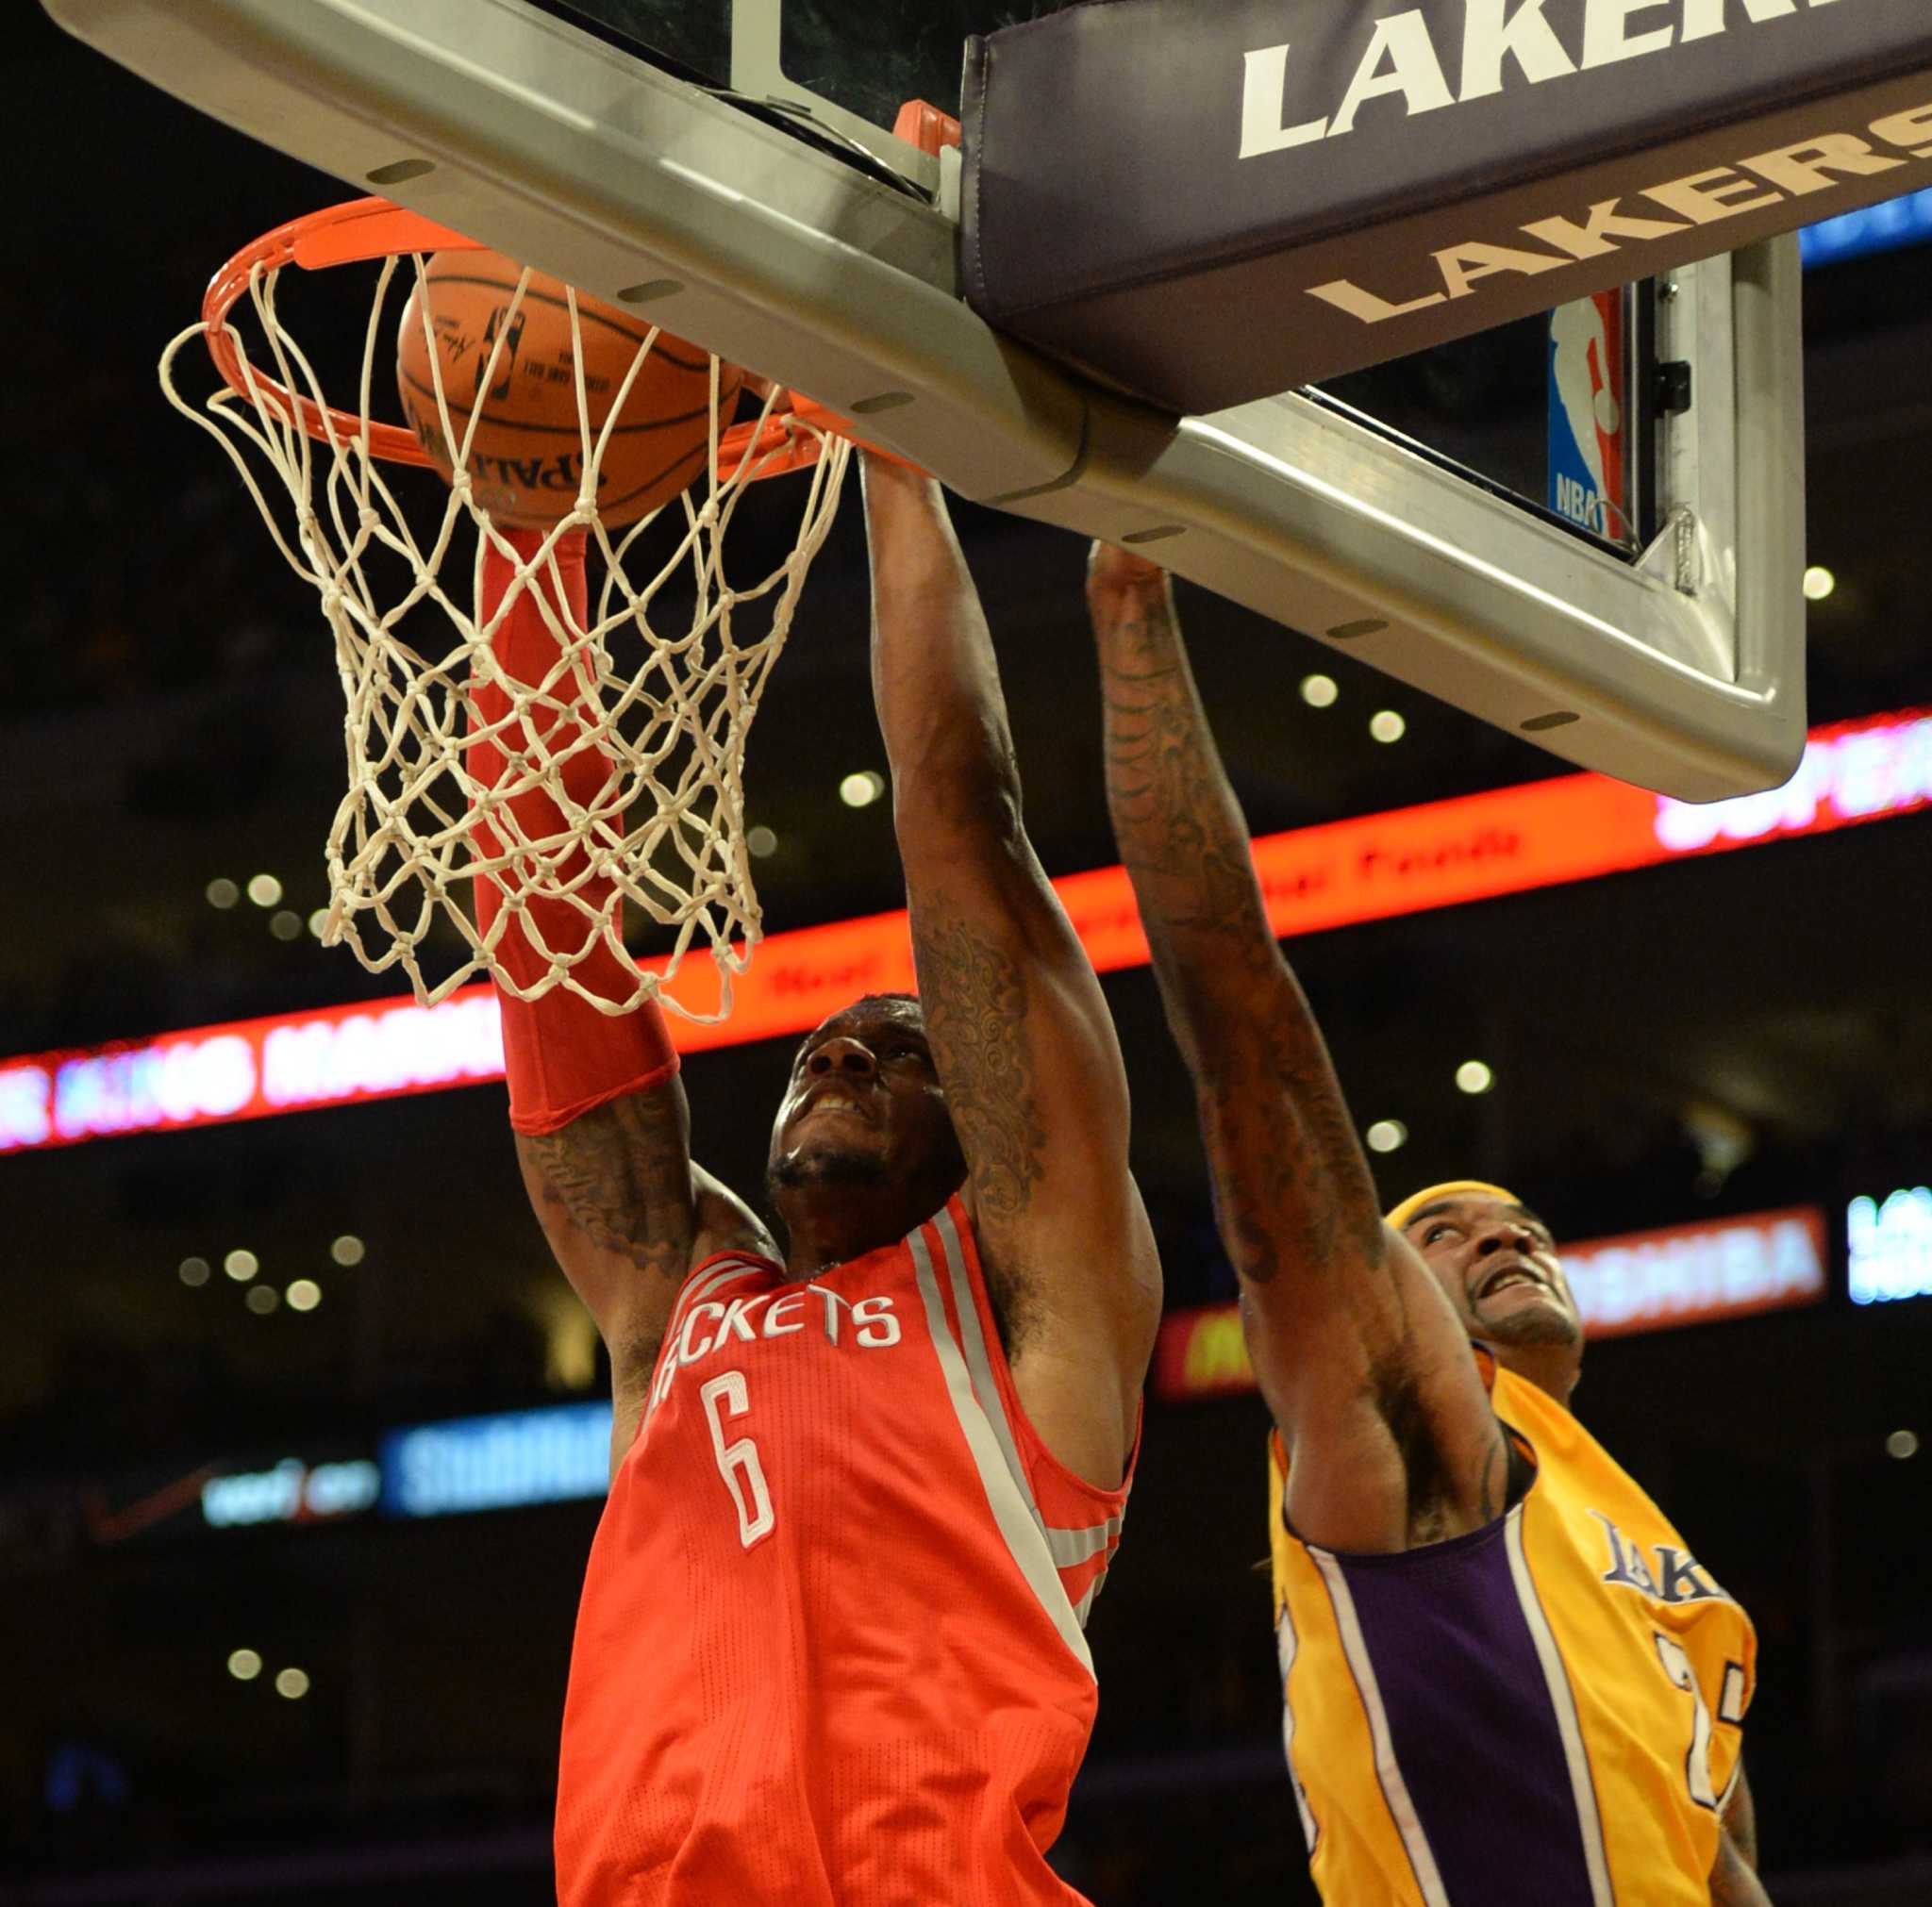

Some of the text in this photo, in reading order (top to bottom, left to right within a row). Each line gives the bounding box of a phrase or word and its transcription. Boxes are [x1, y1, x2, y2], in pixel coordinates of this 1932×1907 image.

[1239, 0, 1841, 160] LAKE
[1557, 473, 1603, 535] NBA
[699, 1369, 776, 1550] 6
